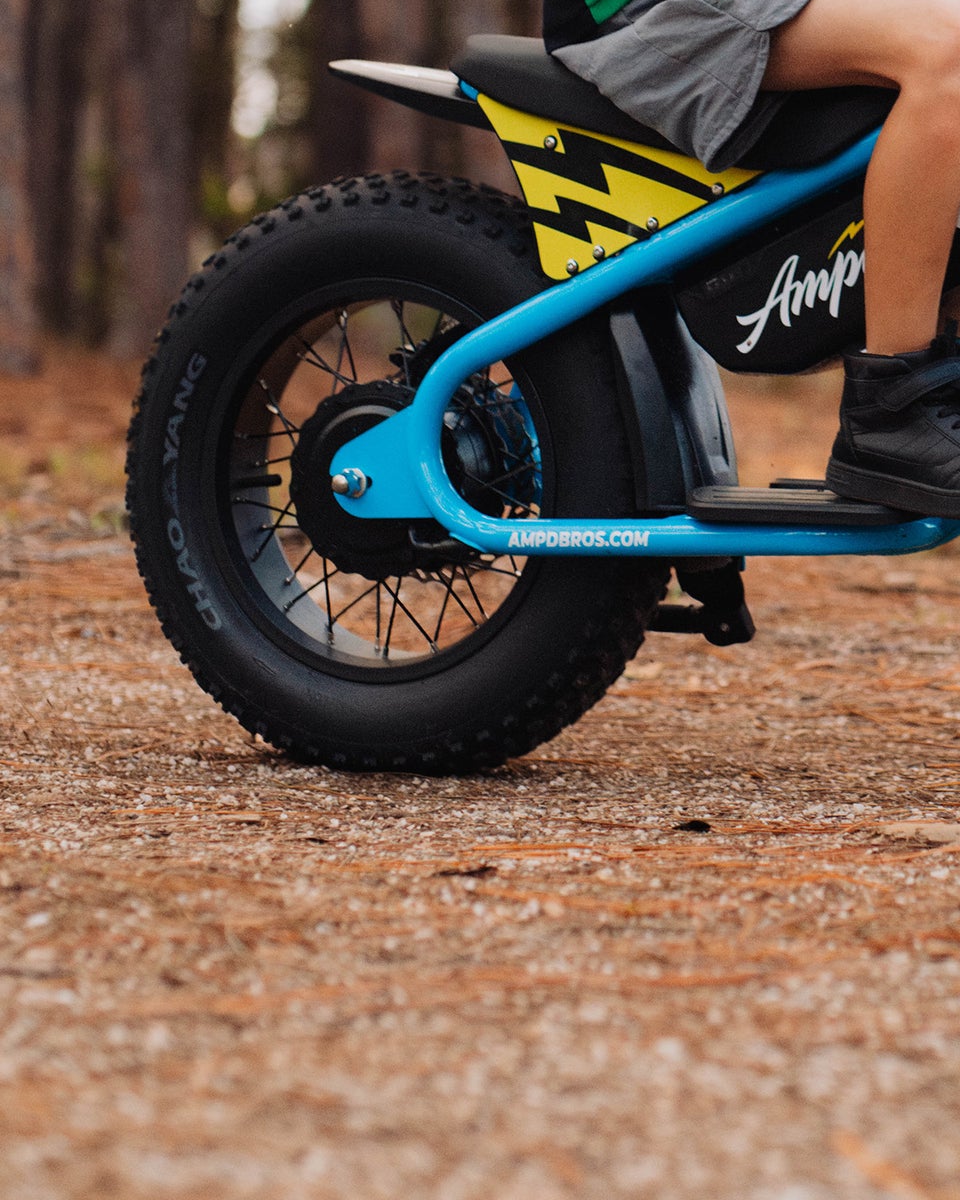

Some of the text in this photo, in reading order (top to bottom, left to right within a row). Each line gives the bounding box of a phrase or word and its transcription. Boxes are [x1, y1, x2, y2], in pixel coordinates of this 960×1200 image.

[736, 250, 867, 354] Amp
[163, 352, 221, 630] CHAO YANG
[508, 530, 650, 548] AMPDBROS.COM
